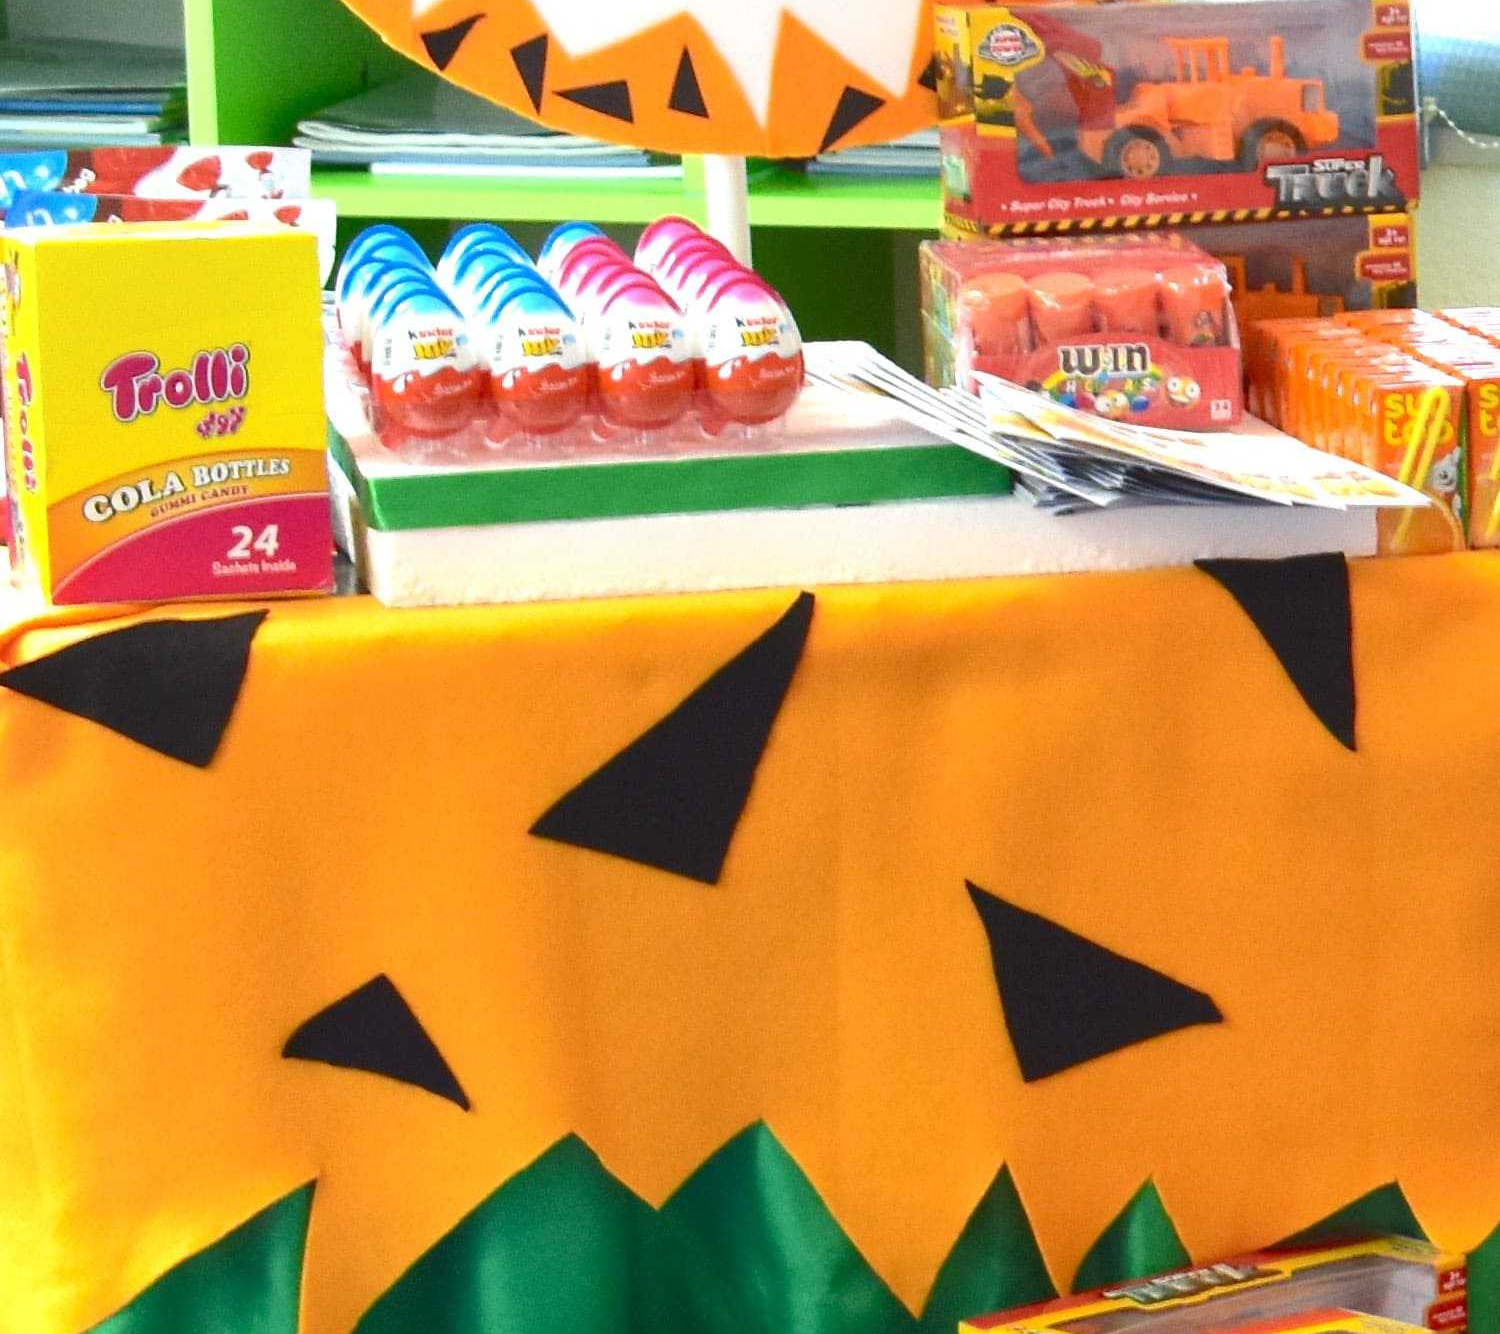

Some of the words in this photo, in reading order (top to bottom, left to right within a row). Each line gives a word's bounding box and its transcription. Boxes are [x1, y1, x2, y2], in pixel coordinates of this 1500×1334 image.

[101, 343, 250, 421] Trolli
[83, 471, 186, 522] COLA
[193, 458, 290, 487] BOTTLES
[202, 485, 249, 501] CANDY
[227, 524, 279, 559] 24
[212, 561, 260, 576] Sachets
[261, 559, 296, 573] Inside
